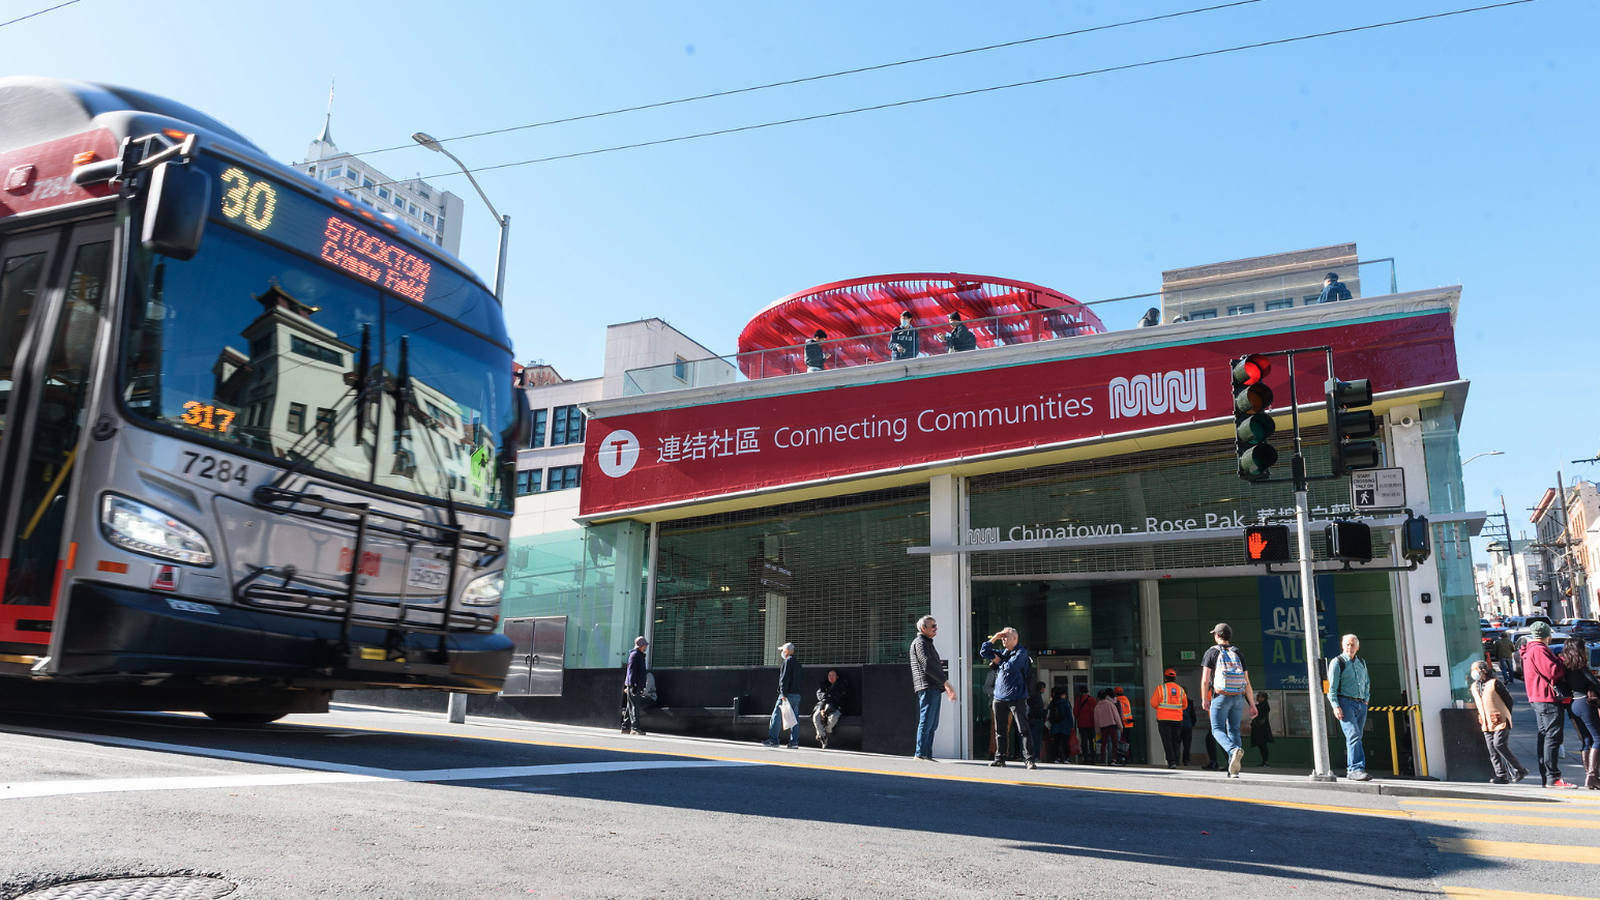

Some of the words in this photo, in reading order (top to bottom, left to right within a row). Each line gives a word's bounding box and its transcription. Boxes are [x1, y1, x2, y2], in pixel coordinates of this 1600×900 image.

[220, 167, 276, 231] 30
[324, 216, 432, 284] STOCKTON
[181, 400, 237, 433] 317
[774, 414, 908, 449] Connecting
[917, 393, 1095, 433] Communities
[183, 450, 250, 487] 7284
[1008, 523, 1123, 543] Chinatown
[1145, 517, 1198, 535] Rose
[1204, 509, 1246, 531] Pak
[1272, 639, 1287, 664] A
